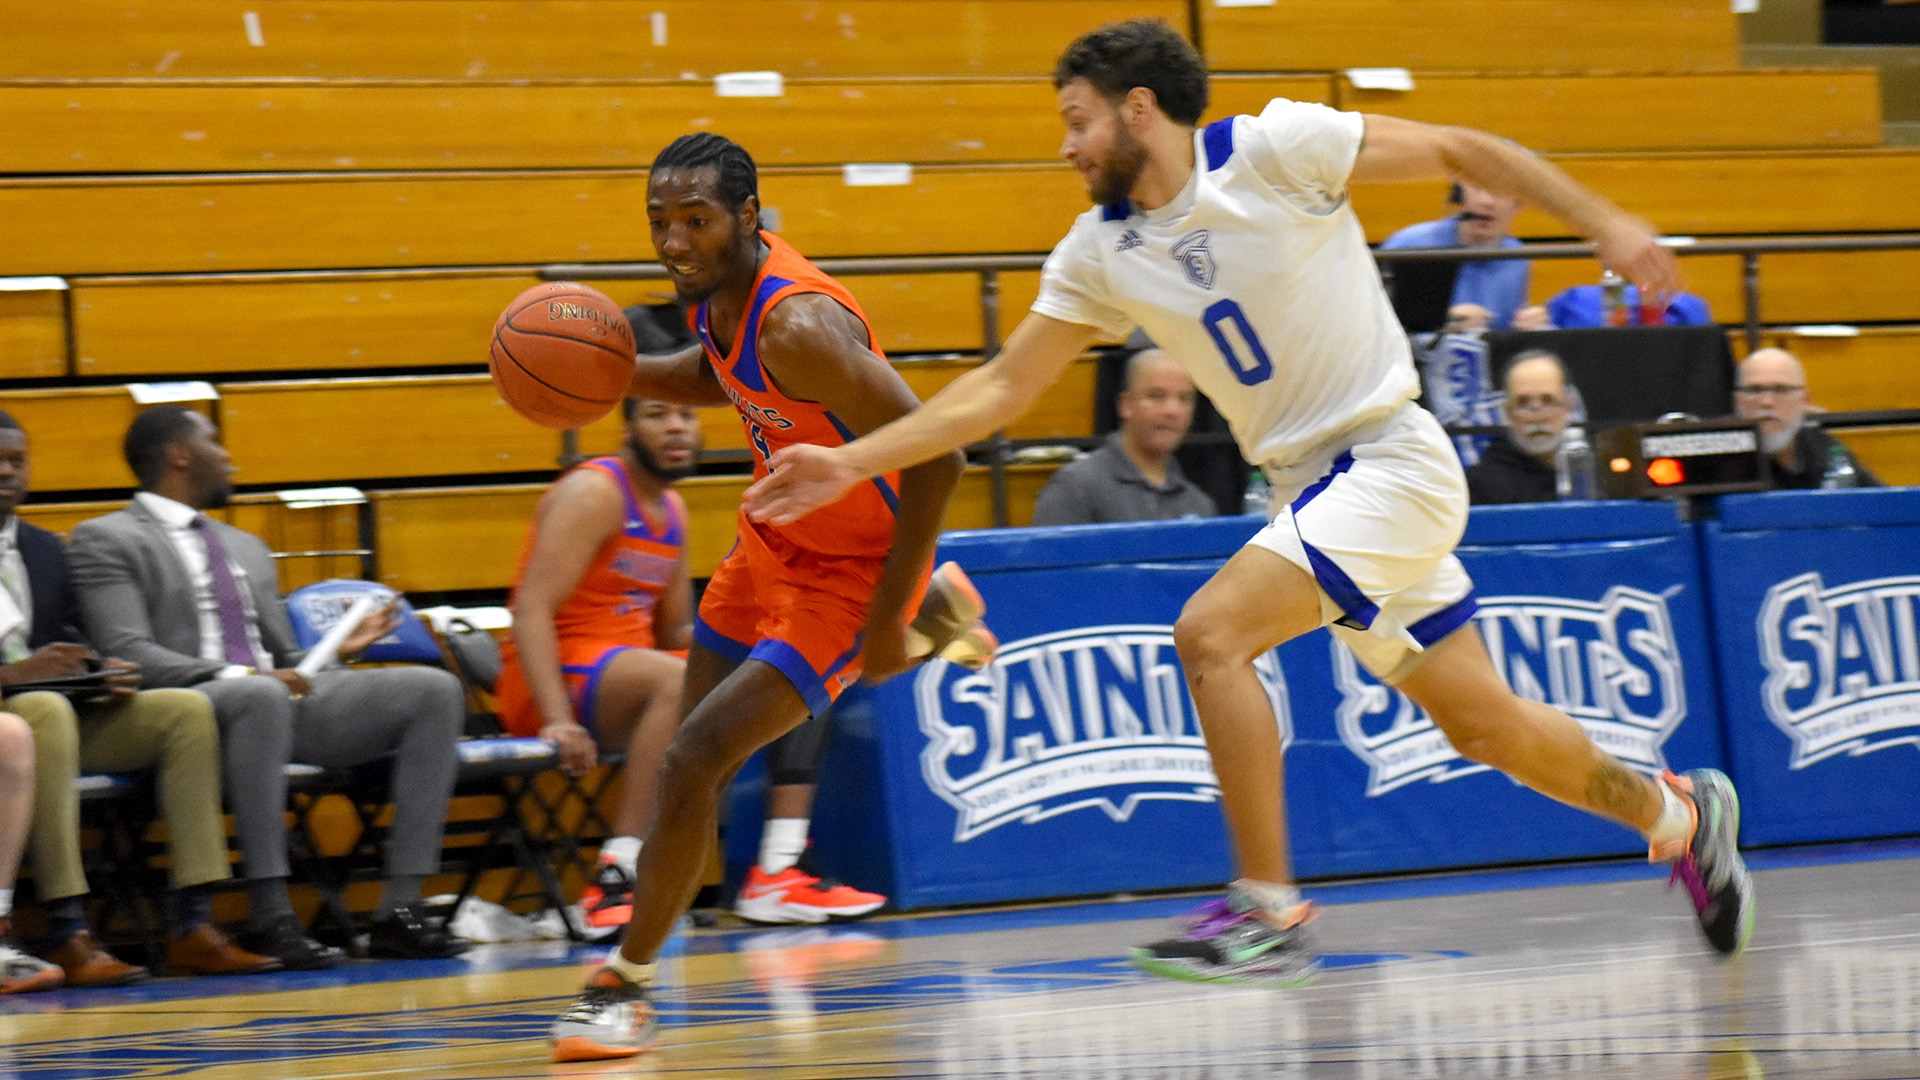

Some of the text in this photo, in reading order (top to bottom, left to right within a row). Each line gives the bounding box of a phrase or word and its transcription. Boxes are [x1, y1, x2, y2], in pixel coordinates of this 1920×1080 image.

[1202, 298, 1274, 387] 0
[925, 638, 1288, 786] SAINT
[1762, 578, 1920, 720] SAI
